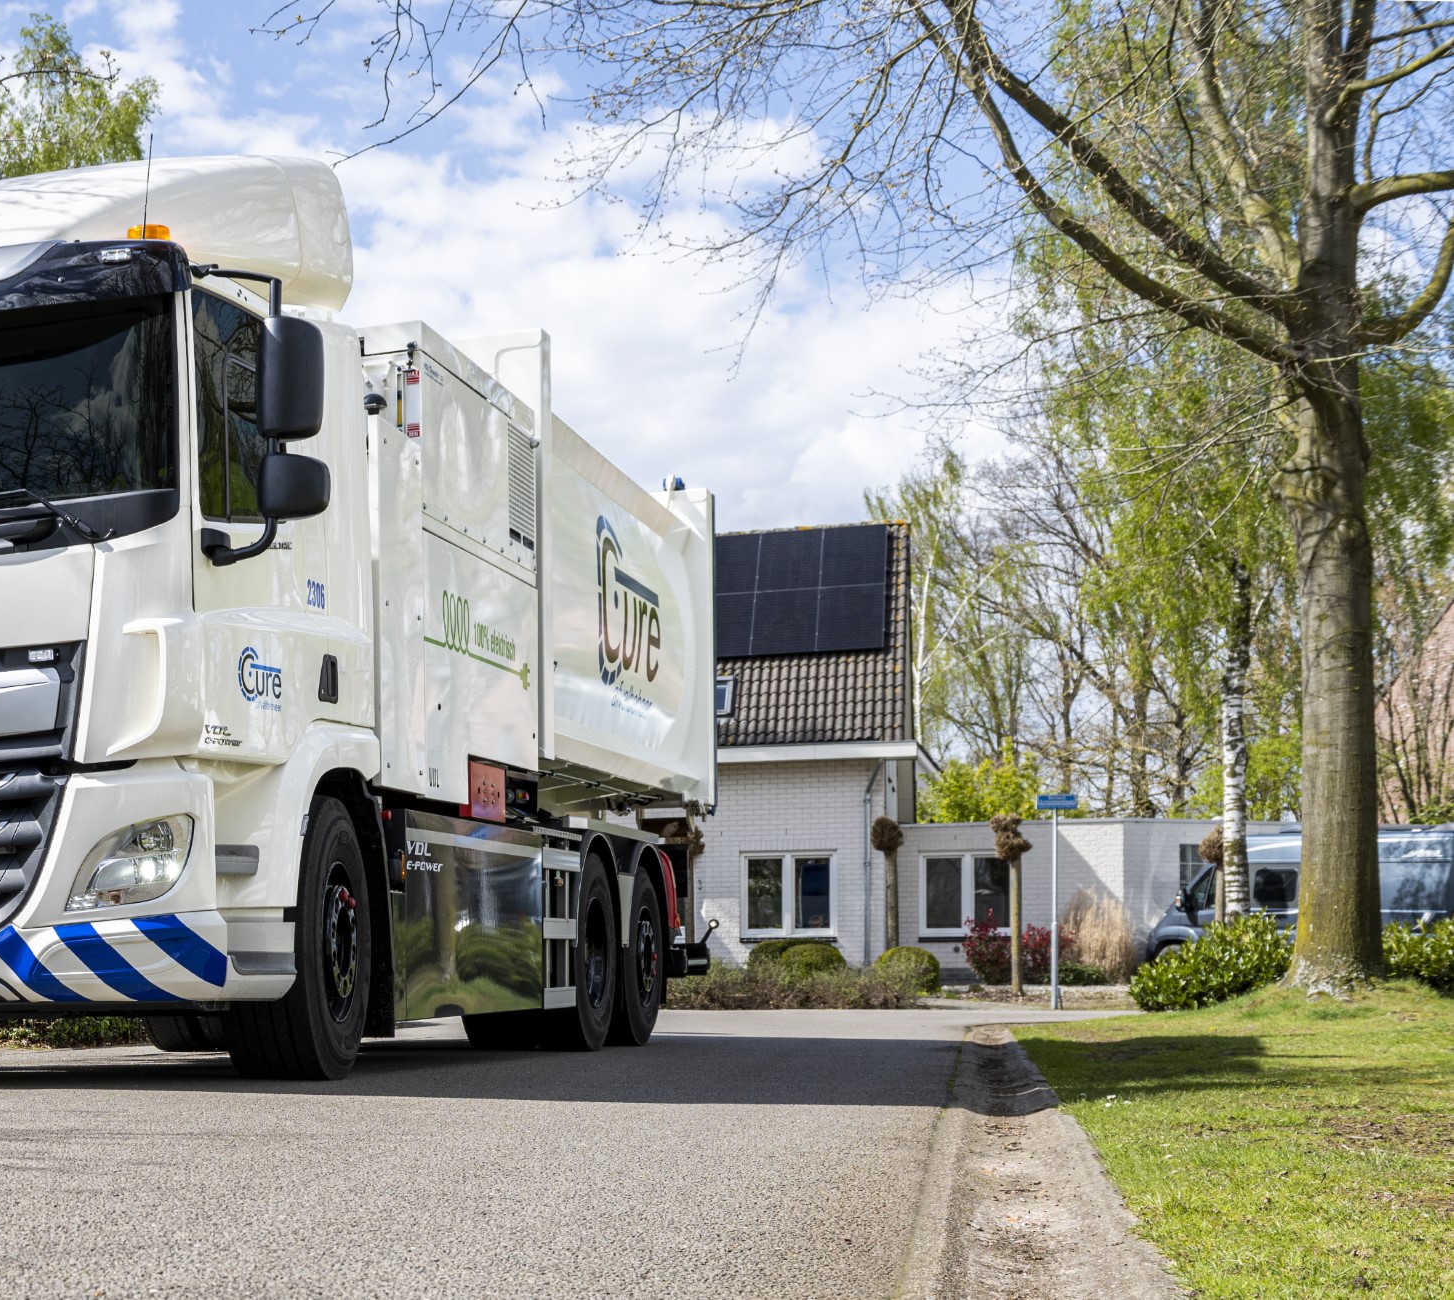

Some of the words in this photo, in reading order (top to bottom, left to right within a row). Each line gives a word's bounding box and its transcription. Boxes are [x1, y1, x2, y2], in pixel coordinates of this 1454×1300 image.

[406, 370, 419, 378] MAX
[307, 579, 325, 610] 2306
[602, 537, 661, 682] Cure
[474, 621, 490, 651] 100%
[490, 629, 515, 662] elektrisch
[240, 652, 282, 699] Cure
[406, 841, 432, 857] VDL
